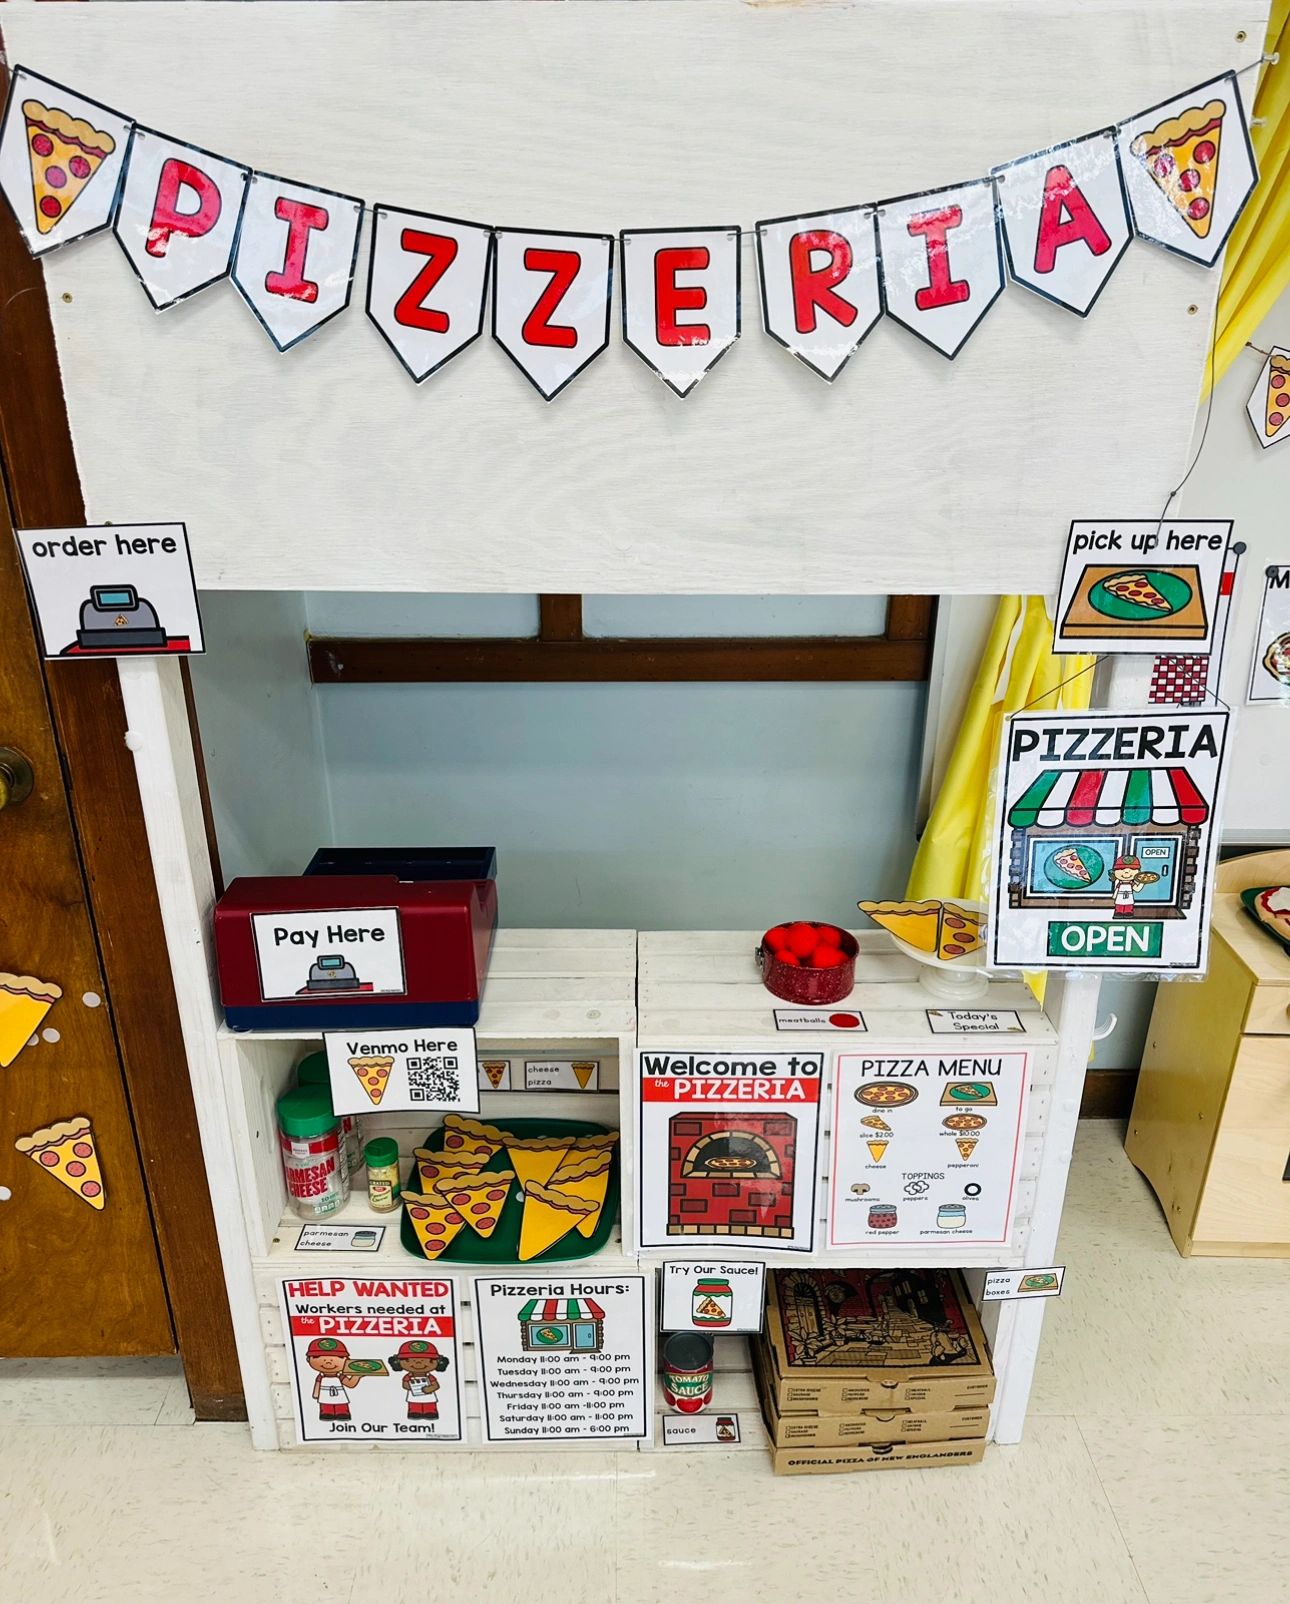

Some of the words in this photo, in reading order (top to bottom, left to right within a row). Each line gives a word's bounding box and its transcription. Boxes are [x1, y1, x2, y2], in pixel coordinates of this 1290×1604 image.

[145, 157, 1112, 348] PIZZERIA
[32, 536, 107, 557] order
[115, 534, 177, 555] here
[1072, 529, 1122, 554] pick
[1131, 534, 1159, 554] up
[1166, 529, 1223, 550] here
[1012, 724, 1218, 762] PIZZERIA
[1144, 848, 1167, 857] OPEN
[273, 926, 319, 948] Pay
[327, 924, 386, 944] Here
[1061, 925, 1150, 952] OPEN
[778, 1016, 827, 1024] meatballs
[950, 1011, 998, 1022] Today's
[953, 1022, 1000, 1032] Special
[346, 1041, 409, 1056] Venmo
[414, 1039, 458, 1053] Here
[527, 1065, 560, 1074] cheese
[644, 1056, 777, 1077] Welcome
[788, 1056, 818, 1077] to
[861, 1059, 930, 1077] PIZZA
[938, 1058, 1003, 1076] MENU
[654, 1079, 670, 1088] the
[673, 1079, 806, 1100] PIZZERIA
[902, 1172, 945, 1180] TOPPINGS
[669, 1265, 690, 1275] Try
[693, 1265, 716, 1275] Our
[720, 1265, 758, 1275] Sauce!
[987, 1276, 1011, 1285] pizza
[288, 1281, 345, 1297] HELP
[353, 1281, 449, 1297] WANTED
[490, 1284, 564, 1296] Pizzeria
[570, 1284, 630, 1295] Hours:
[985, 1288, 1011, 1296] boxes
[296, 1304, 362, 1314] Workers
[367, 1304, 425, 1315] needed
[429, 1305, 446, 1314] at
[300, 1316, 315, 1324] the
[319, 1316, 441, 1335] PIZZERIA
[496, 1355, 537, 1364] Monday
[614, 1354, 631, 1362] pm
[497, 1368, 539, 1376] Tuesday
[615, 1366, 631, 1374] pm
[490, 1380, 547, 1388] Wednesday
[623, 1377, 640, 1385] pm
[668, 1373, 709, 1383] TOMATO
[671, 1381, 709, 1396] SAUCE
[497, 1392, 542, 1400] Thursday
[618, 1390, 634, 1398] pm
[506, 1403, 539, 1411] Friday
[609, 1402, 625, 1410] pm
[617, 1413, 634, 1421] pm
[329, 1423, 357, 1433] Join
[361, 1423, 388, 1433] Our
[393, 1423, 435, 1433] Team!
[504, 1427, 539, 1435] Sunday
[614, 1425, 630, 1433] pm
[666, 1427, 696, 1435] sauce
[906, 1451, 973, 1460] ENGLANDERS
